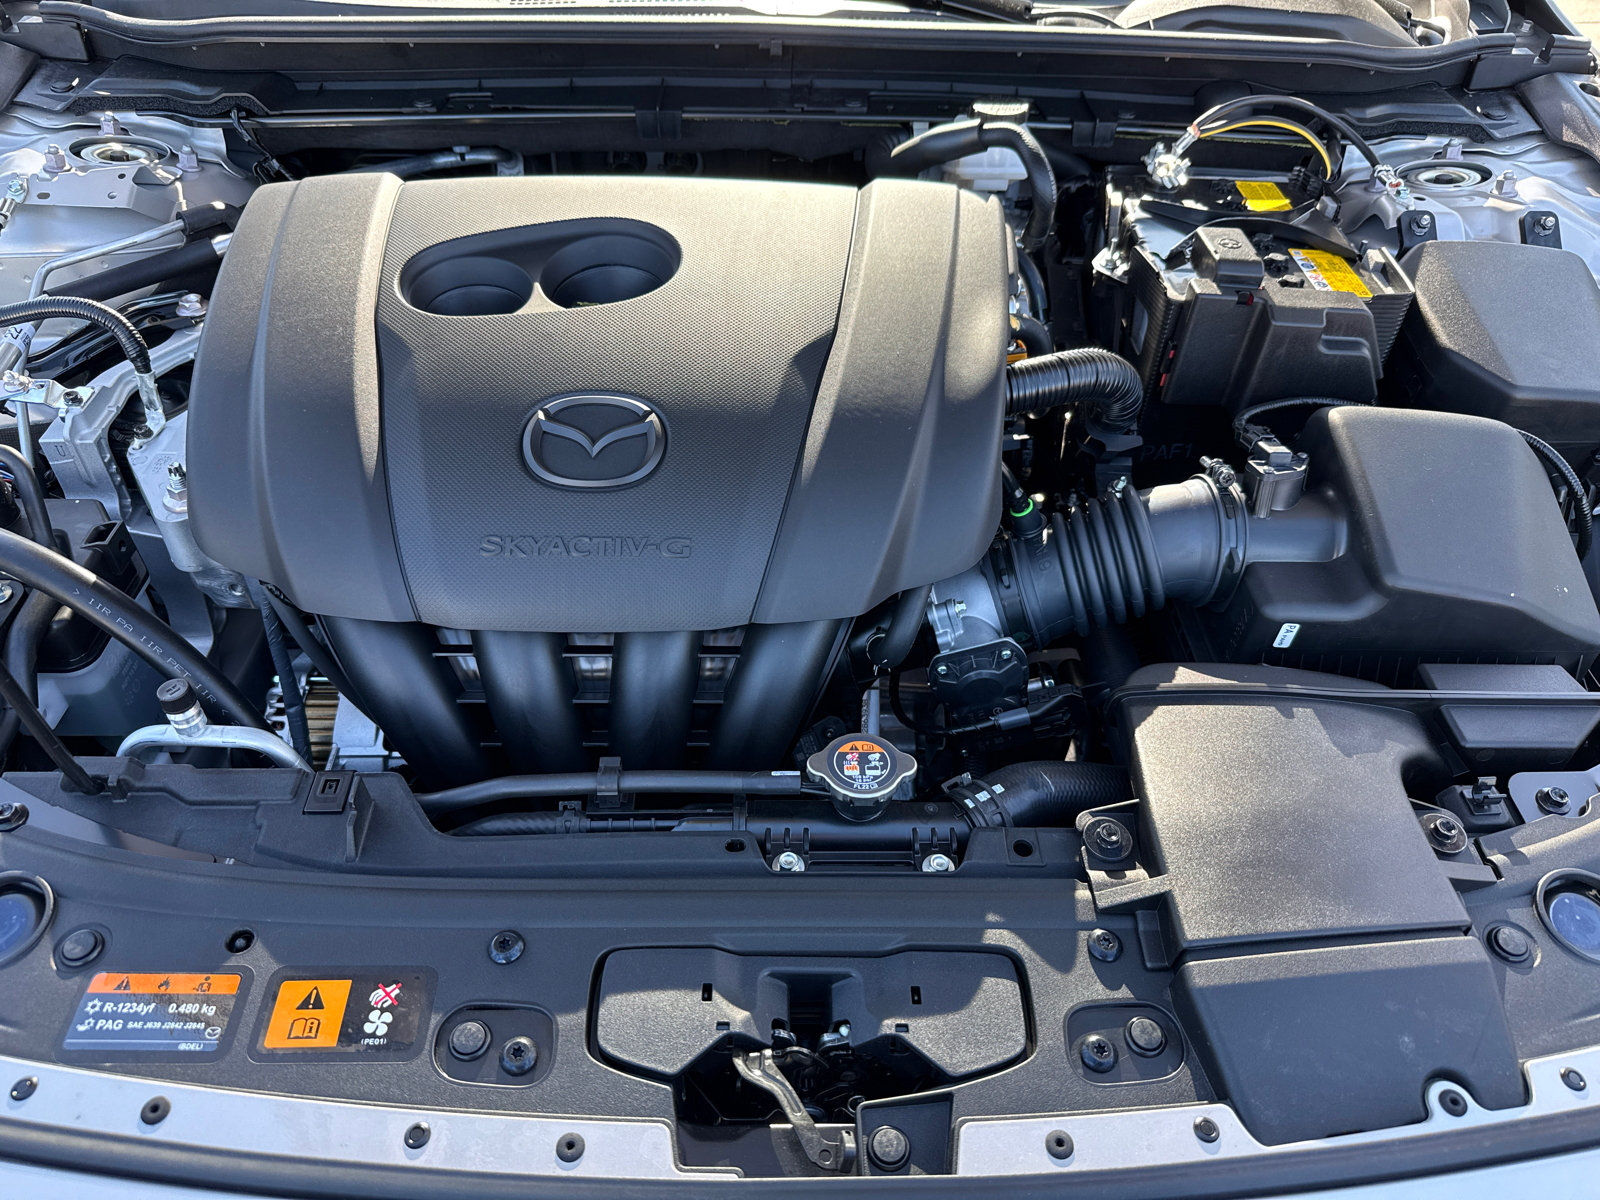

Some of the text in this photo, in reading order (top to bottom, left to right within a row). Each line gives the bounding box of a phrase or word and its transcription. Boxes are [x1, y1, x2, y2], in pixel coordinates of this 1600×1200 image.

[1140, 443, 1193, 460] PAF1
[480, 535, 692, 558] SKYACTIV-G
[88, 598, 112, 616] IIR
[116, 617, 134, 632] PA
[140, 635, 163, 655] IIR
[166, 657, 191, 677] PET
[103, 1002, 216, 1016] R-1234yf 0.480 kg
[95, 1019, 124, 1031] PAG
[127, 1021, 144, 1029] SAE
[143, 1021, 162, 1029] J639
[183, 1021, 205, 1030] J2845
[178, 1043, 203, 1051] (BDEL)
